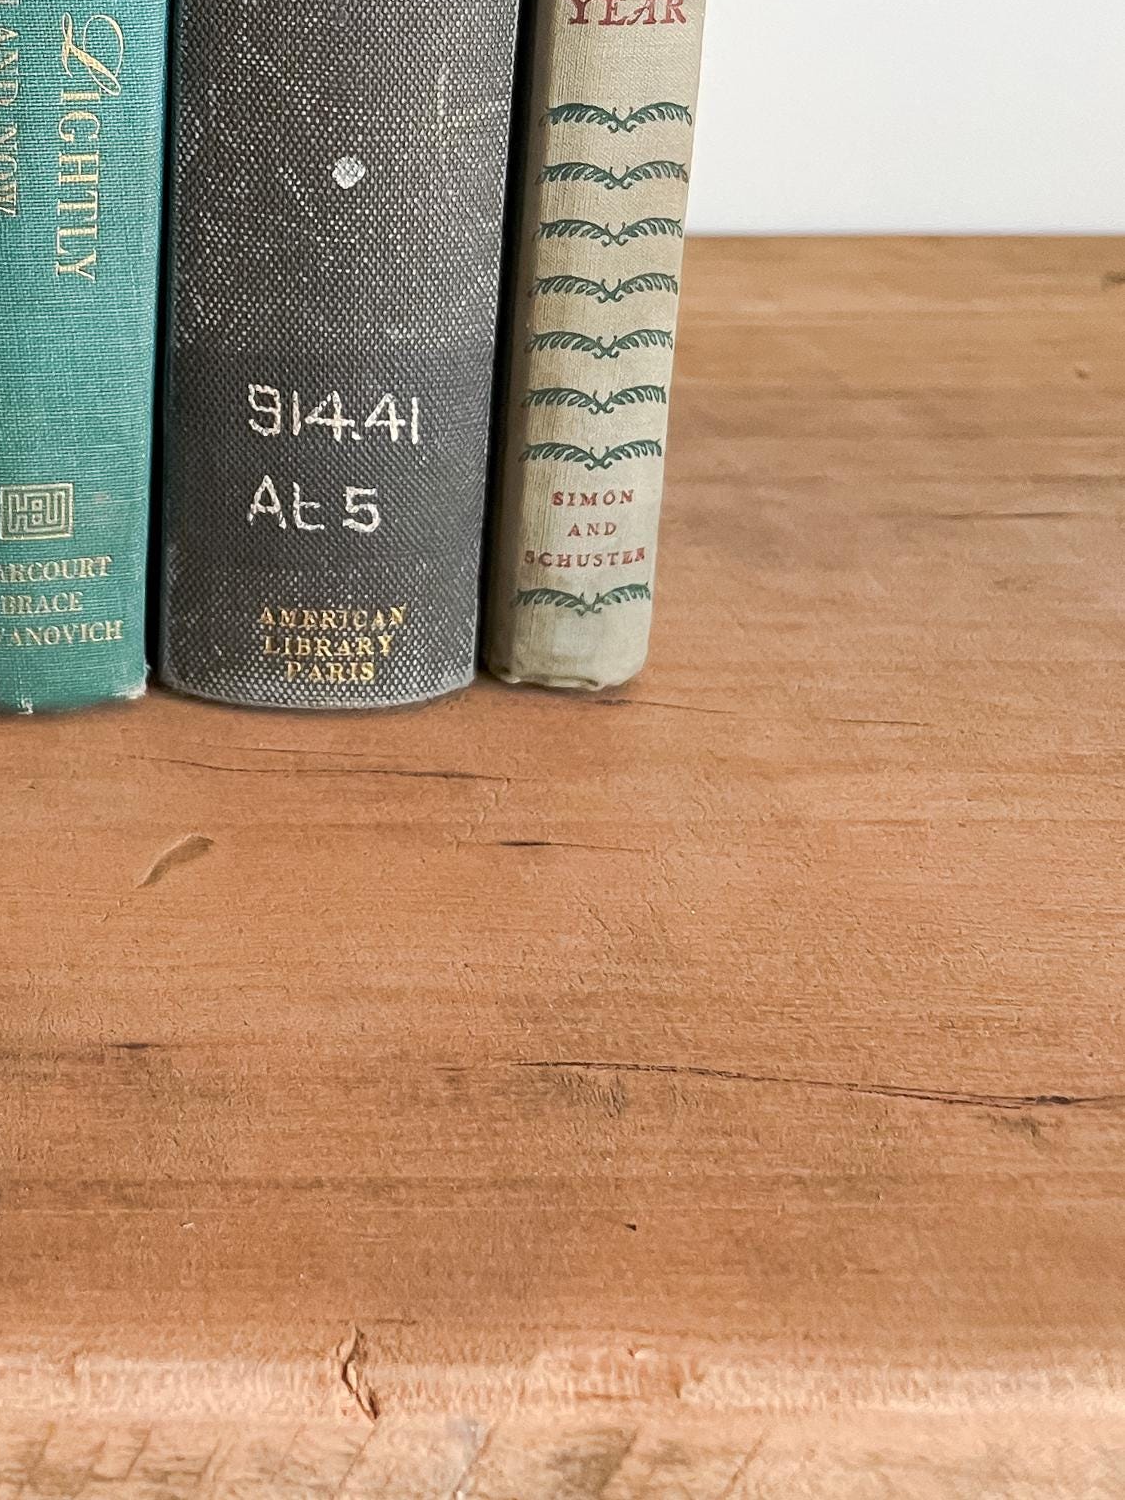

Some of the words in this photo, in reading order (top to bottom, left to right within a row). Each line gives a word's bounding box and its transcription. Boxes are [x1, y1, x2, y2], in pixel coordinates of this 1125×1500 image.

[55, 11, 124, 284] LIGHTLY
[247, 383, 420, 445] 914.41
[342, 486, 380, 533] 5
[551, 489, 635, 507] SIMON
[567, 521, 617, 537] AND
[525, 547, 646, 568] SCHUSTER
[0, 591, 84, 615] BRACE
[258, 604, 408, 630] AMERICAN
[262, 634, 395, 658] LIBRARY
[284, 660, 377, 683] PARIS
